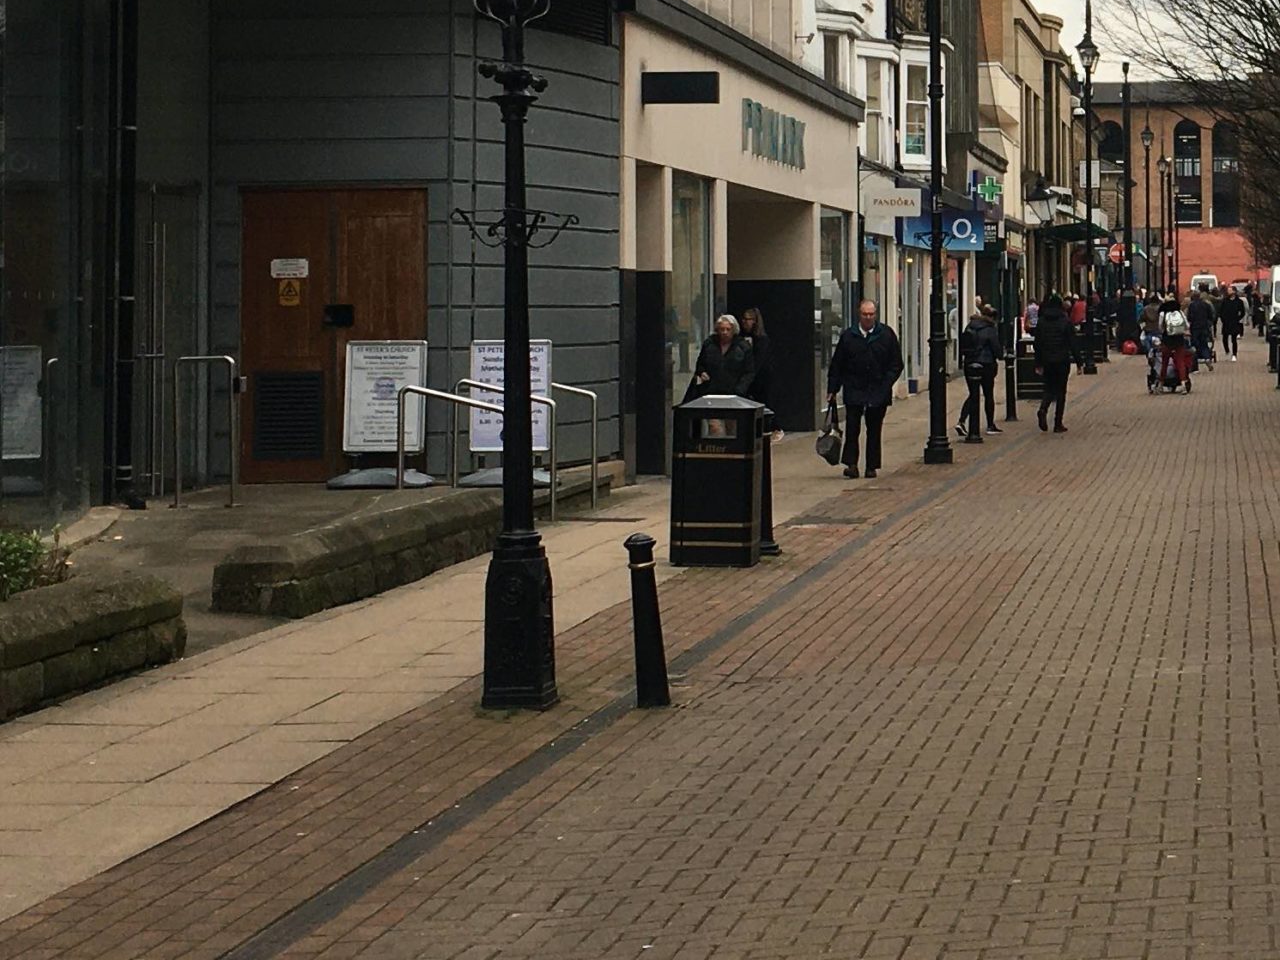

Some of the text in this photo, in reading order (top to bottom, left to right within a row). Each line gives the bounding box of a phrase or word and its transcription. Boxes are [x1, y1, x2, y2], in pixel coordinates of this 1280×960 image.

[741, 97, 807, 171] PRIMARK
[873, 197, 915, 208] PANDORA
[698, 442, 727, 453] Litter
